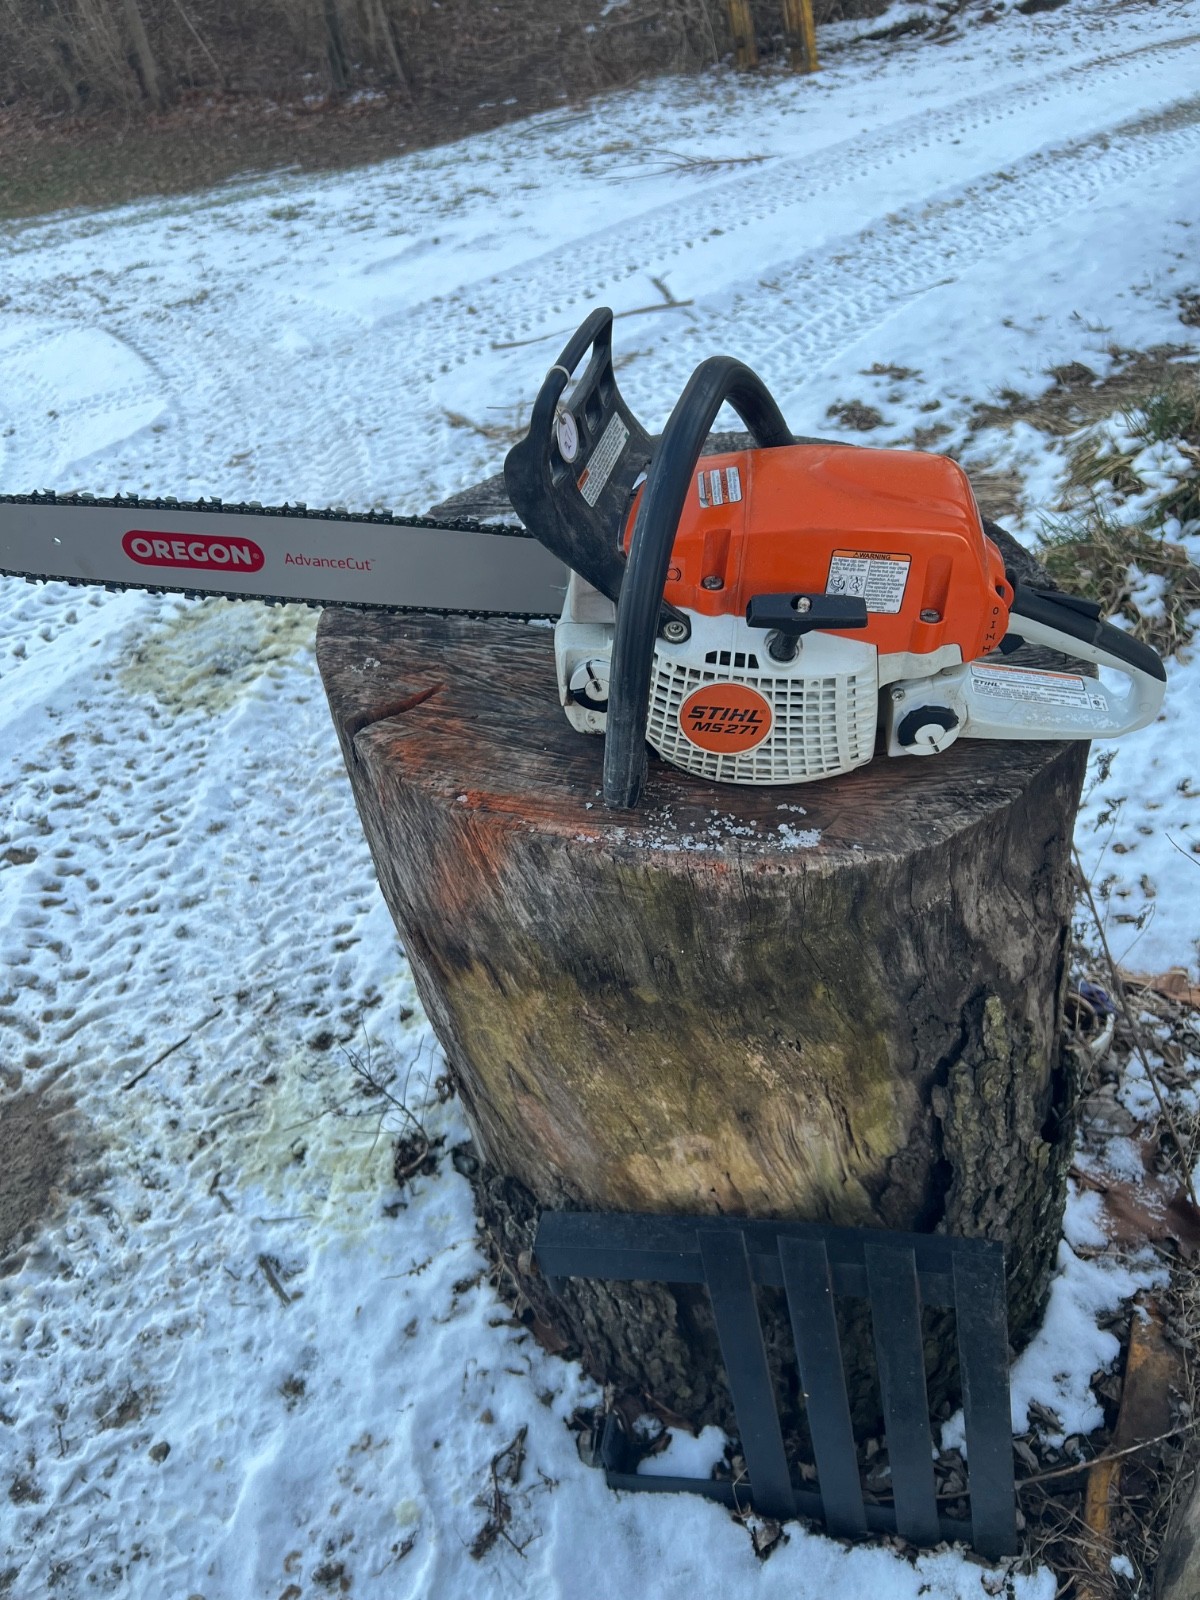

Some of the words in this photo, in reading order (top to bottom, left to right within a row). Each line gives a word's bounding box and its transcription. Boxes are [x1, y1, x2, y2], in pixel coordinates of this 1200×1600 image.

[131, 537, 253, 565] OREGON
[860, 552, 891, 560] WARNING
[285, 552, 372, 571] AdvanceCut
[688, 705, 763, 723] STIHL
[692, 722, 724, 733] MS
[724, 724, 759, 735] 271
